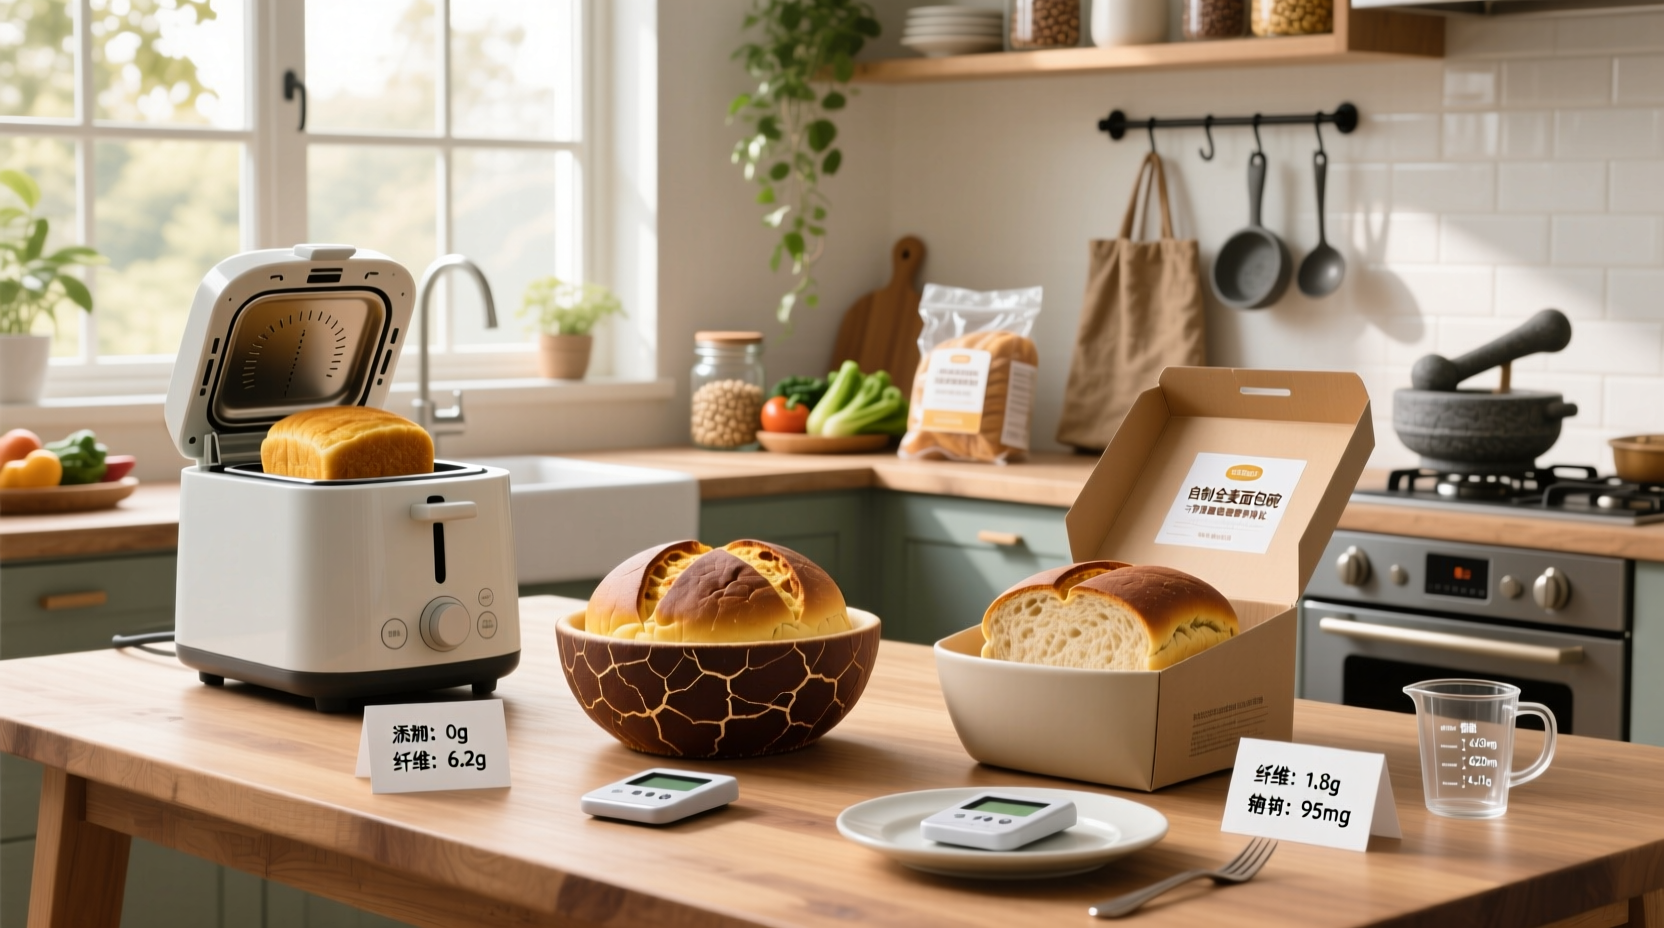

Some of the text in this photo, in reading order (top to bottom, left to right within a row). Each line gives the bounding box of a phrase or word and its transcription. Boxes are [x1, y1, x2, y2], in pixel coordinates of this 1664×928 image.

[446, 724, 468, 744] 0g
[448, 750, 487, 771] 6.2g
[1306, 772, 1341, 797] 1.8g
[1301, 800, 1352, 828] 95mg
